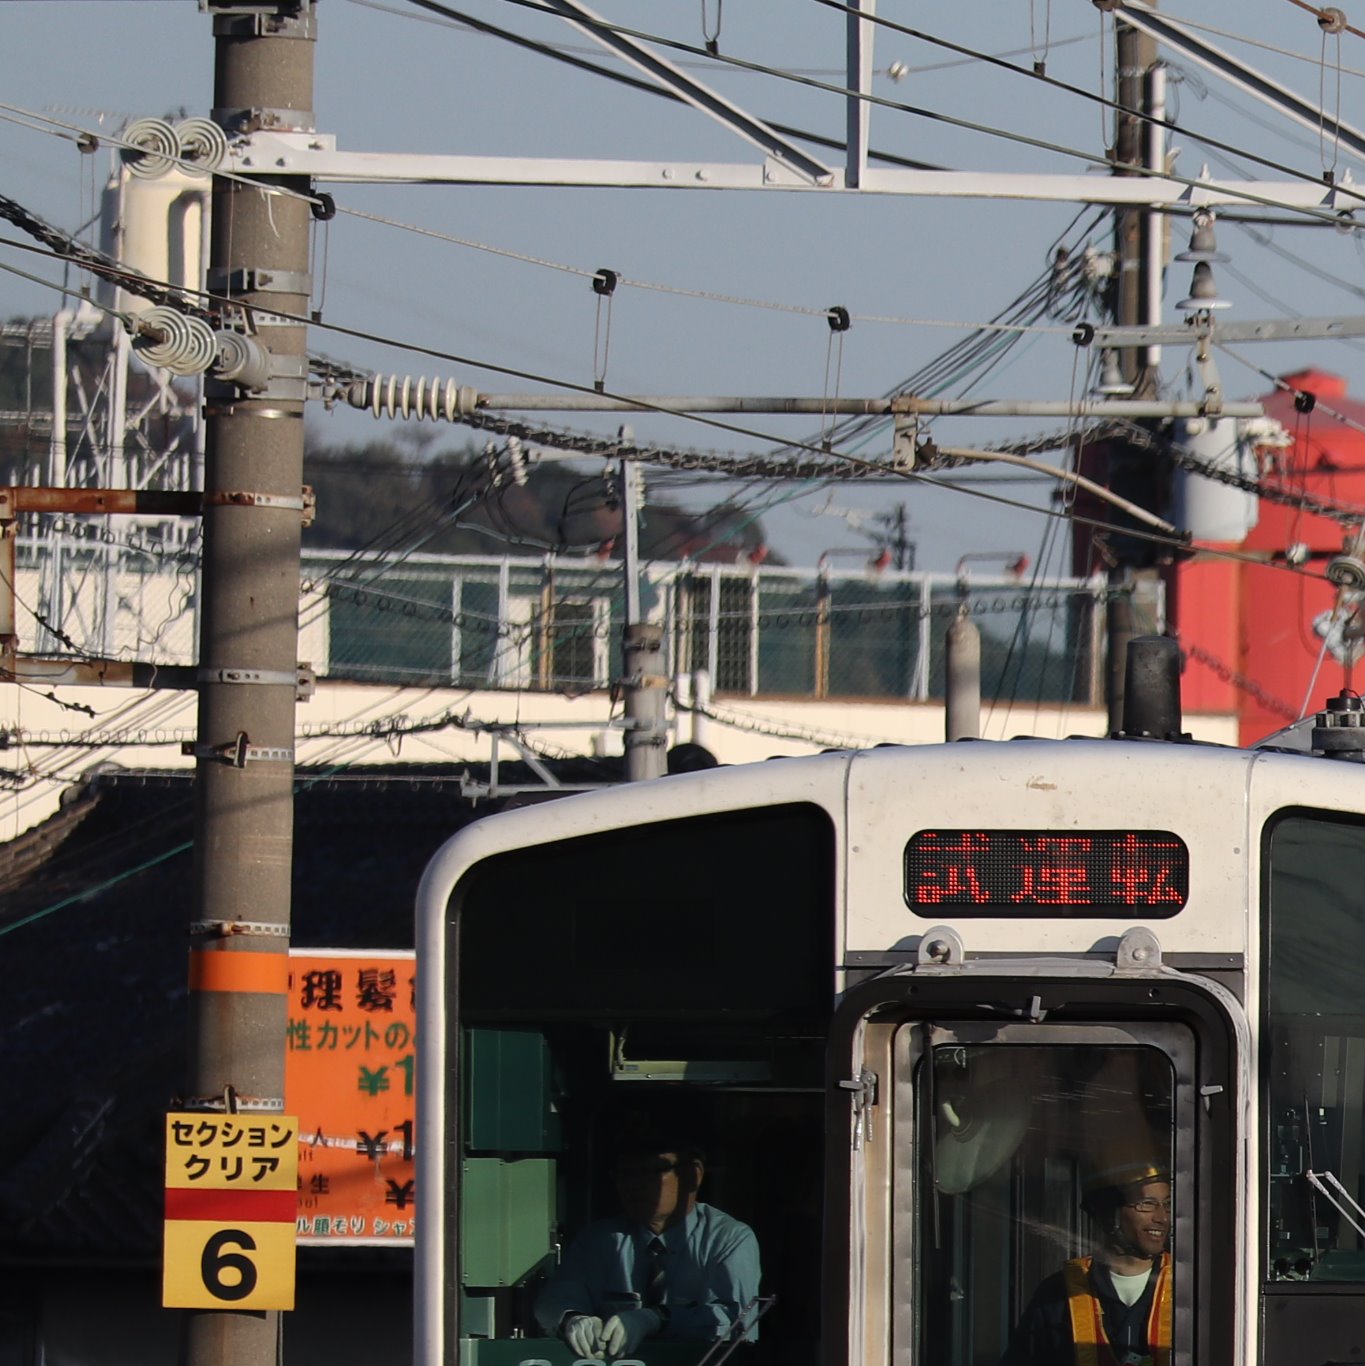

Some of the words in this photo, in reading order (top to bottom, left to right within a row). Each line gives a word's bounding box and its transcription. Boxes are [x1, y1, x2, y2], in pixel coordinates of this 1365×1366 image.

[914, 833, 1184, 904] 試運転
[288, 969, 415, 1013] 理髪
[286, 1018, 416, 1052] 性カットの
[171, 1120, 293, 1149] セクション
[184, 1154, 280, 1182] クリア
[201, 1229, 258, 1301] 6
